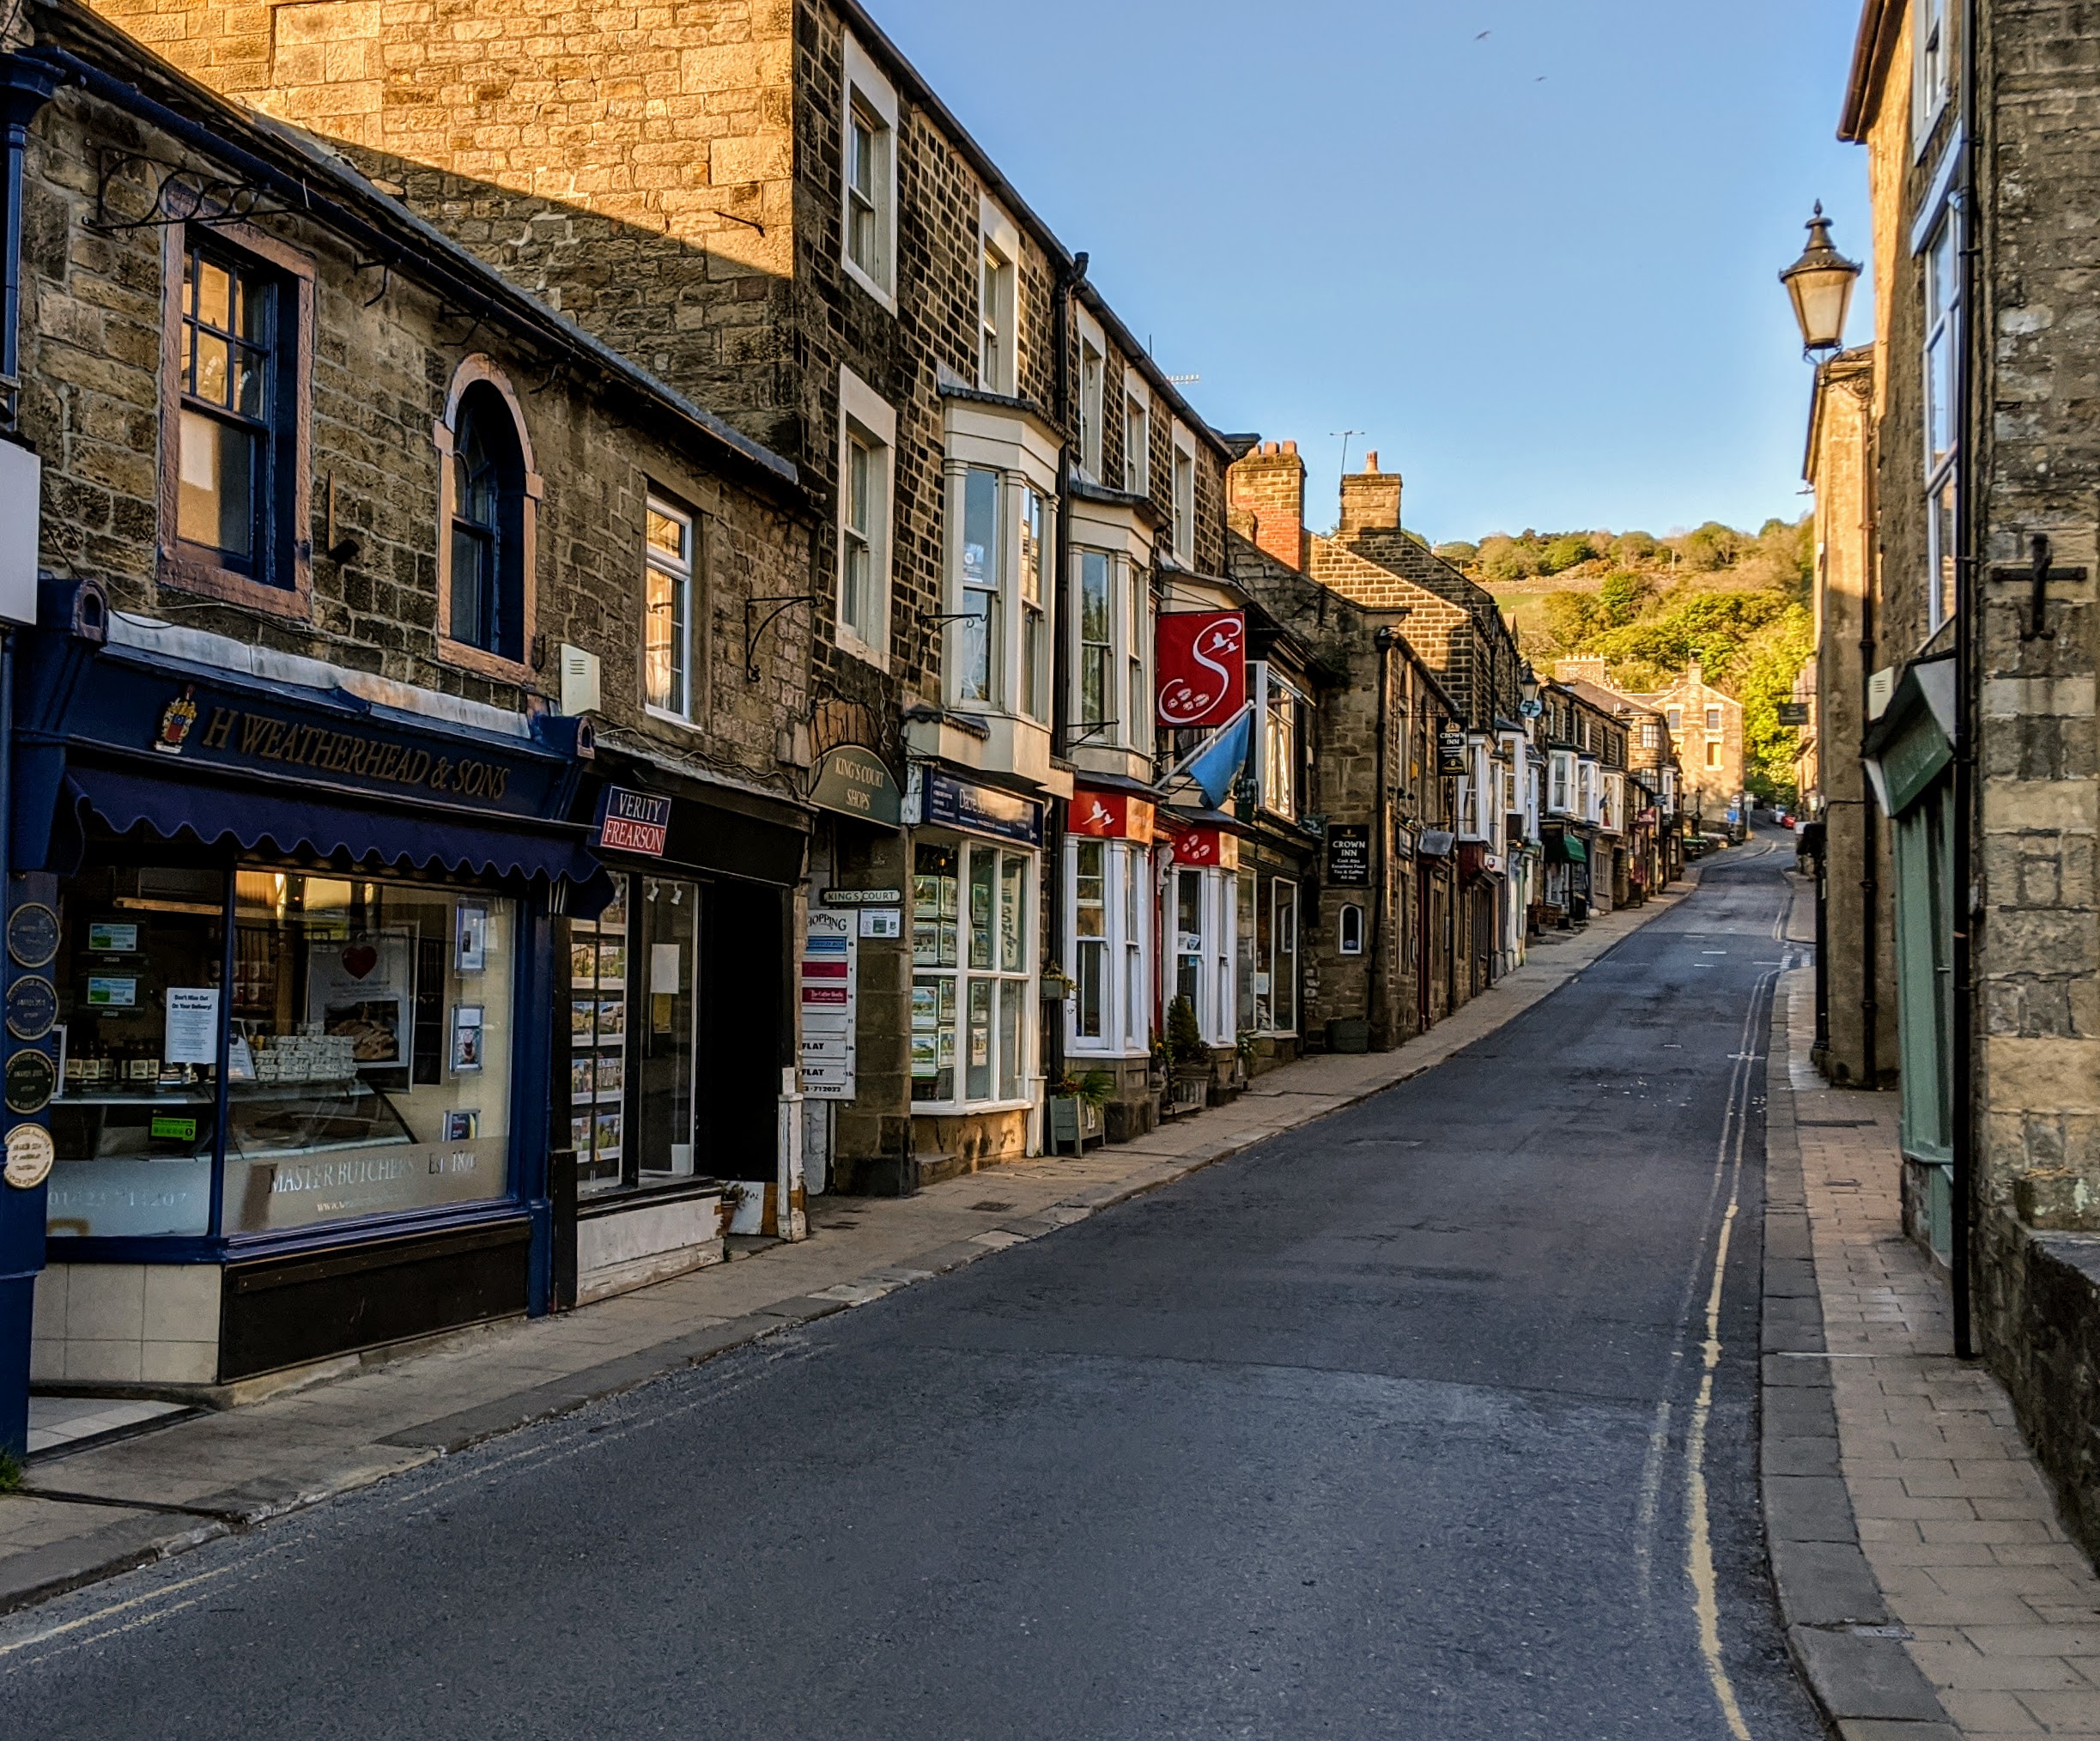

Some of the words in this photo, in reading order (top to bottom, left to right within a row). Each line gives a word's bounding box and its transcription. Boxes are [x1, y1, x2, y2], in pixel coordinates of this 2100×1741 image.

[203, 707, 239, 749] H
[240, 713, 429, 785] WEATHERHEAD
[430, 756, 454, 791] &
[452, 759, 511, 800] SONS
[835, 757, 861, 781] KING'S
[861, 766, 884, 788] COURT
[619, 792, 663, 822] VERITY
[846, 789, 871, 810] SHOPS
[604, 820, 665, 852] FREARSON
[828, 892, 859, 901] KING'S
[862, 891, 895, 901] COURT
[268, 1163, 333, 1193] MASTER
